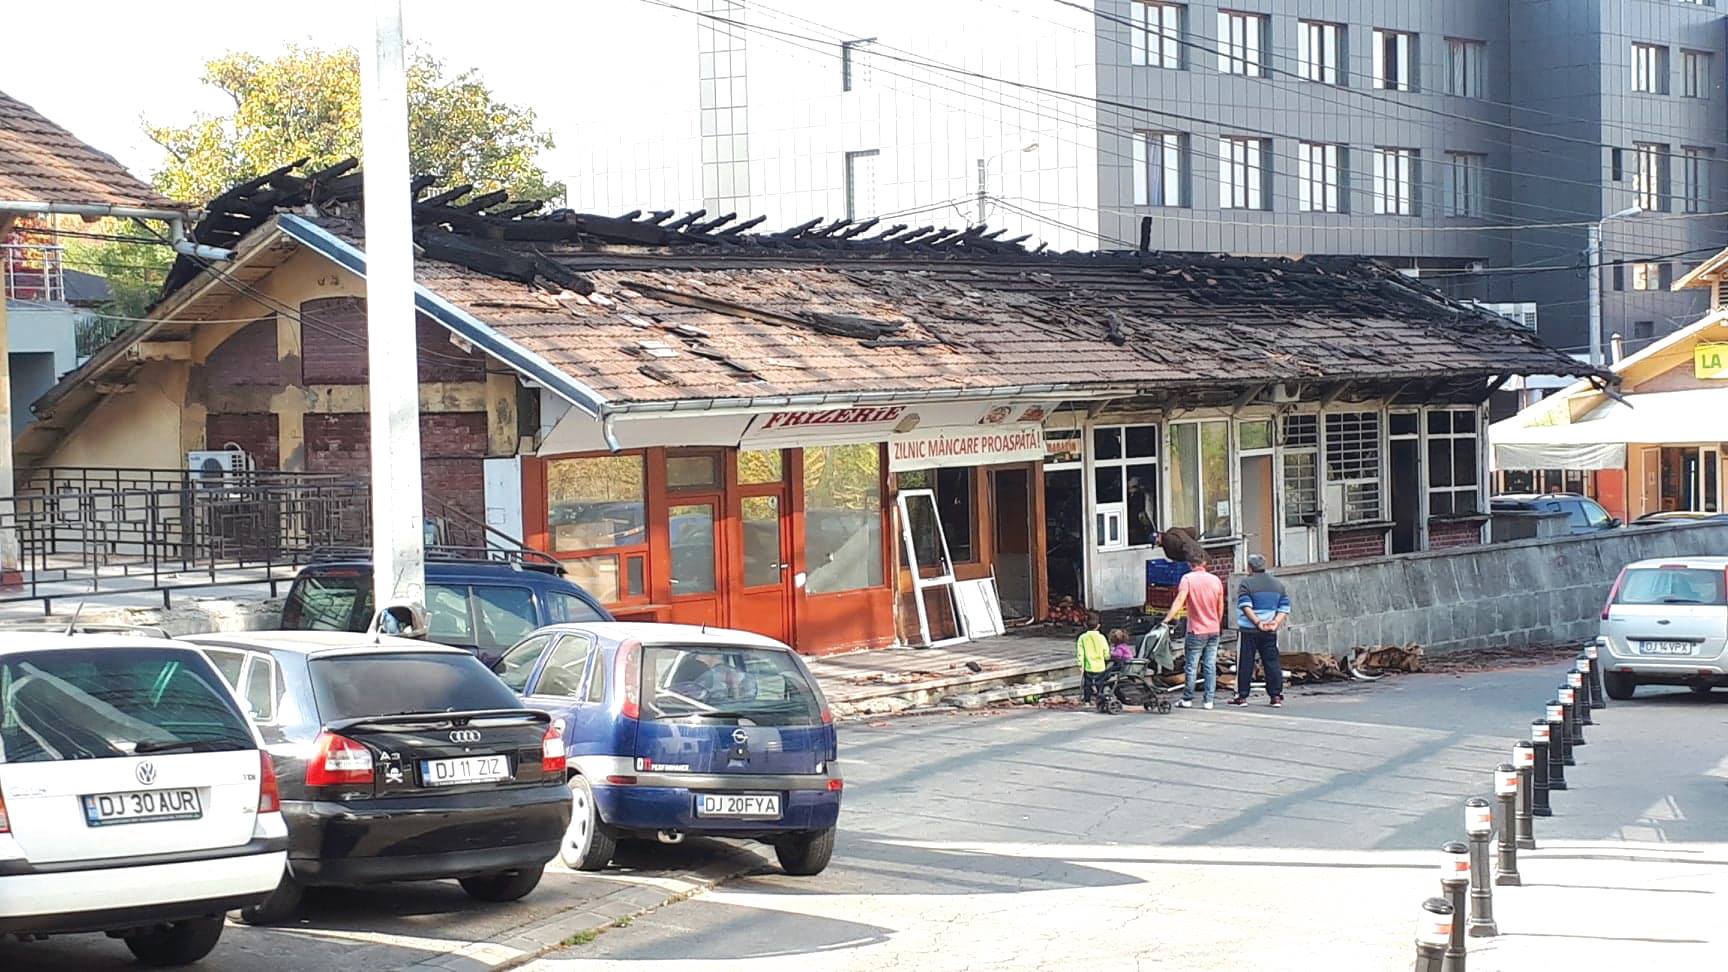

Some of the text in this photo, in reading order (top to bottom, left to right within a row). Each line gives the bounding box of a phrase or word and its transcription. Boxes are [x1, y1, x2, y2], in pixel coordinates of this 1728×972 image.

[1702, 354, 1722, 369] LA
[894, 430, 1041, 460] ZILNIC MÂNCARE PROASPĂTĂ!
[379, 751, 401, 760] A3
[436, 758, 501, 779] DJ 11 ZIZ
[100, 790, 196, 817] DJ 30 AUR
[705, 798, 723, 812] DJ
